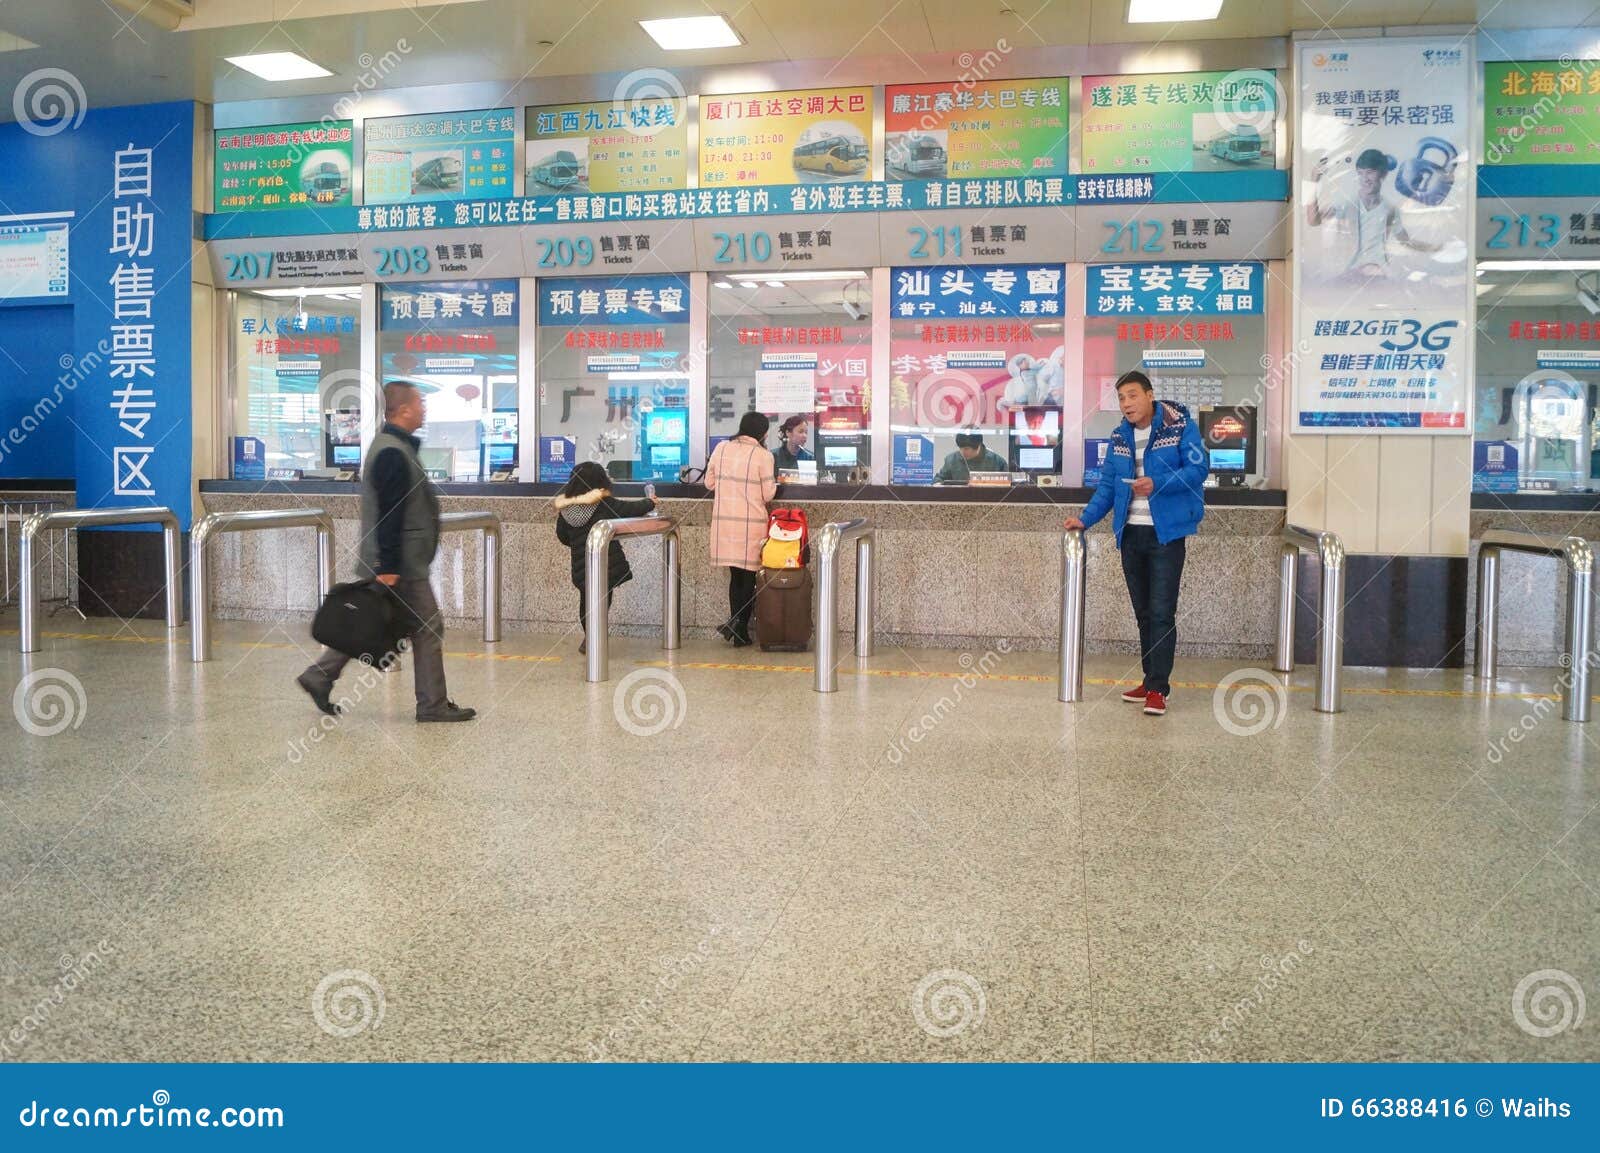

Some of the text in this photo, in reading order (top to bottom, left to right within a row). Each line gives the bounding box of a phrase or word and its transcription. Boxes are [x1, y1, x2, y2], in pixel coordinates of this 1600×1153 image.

[892, 87, 1062, 114] 廉江豪华大巴专线
[1091, 80, 1264, 107] 遂溪专线欢迎您
[1316, 89, 1401, 105] 我爱通话爽
[706, 95, 866, 120] 厦门直达空调大巴
[537, 104, 676, 134] 江西九江快线
[1078, 177, 1153, 198] 宝安专区线路除外
[971, 224, 1027, 243] 售票窗
[1103, 219, 1165, 254] 212
[1172, 217, 1232, 237] 售票窗
[1486, 213, 1561, 250] 213
[600, 234, 650, 252] 售票窗
[712, 231, 771, 264] 210
[778, 229, 832, 249] 售票窗
[907, 225, 963, 259] 211
[1173, 239, 1207, 250] Tickets
[373, 245, 430, 275] 208
[435, 243, 484, 260] 售票窗
[536, 236, 594, 268] 209
[603, 255, 633, 265] Tickets
[781, 252, 812, 262] Tickets
[972, 246, 1005, 256] Tickets
[224, 251, 275, 281] 207
[440, 263, 467, 273] Tickets
[897, 269, 1063, 297] 汕头专窗
[1099, 264, 1254, 293] 宝安专窗
[390, 290, 515, 320] 预售票专窗
[550, 286, 684, 316] 预售票专窗
[899, 299, 1060, 316] 普宁、汕头、澄海
[1098, 294, 1253, 313] 沙井、宝安、福田
[109, 142, 156, 495] 自助售票专区
[737, 327, 844, 345] 请在黄线外自觉排队
[921, 323, 1035, 344] 请在黄线外自觉排队
[1117, 322, 1235, 342] 请在黄线外自觉排队
[1320, 353, 1446, 372] 智能手机用天翼
